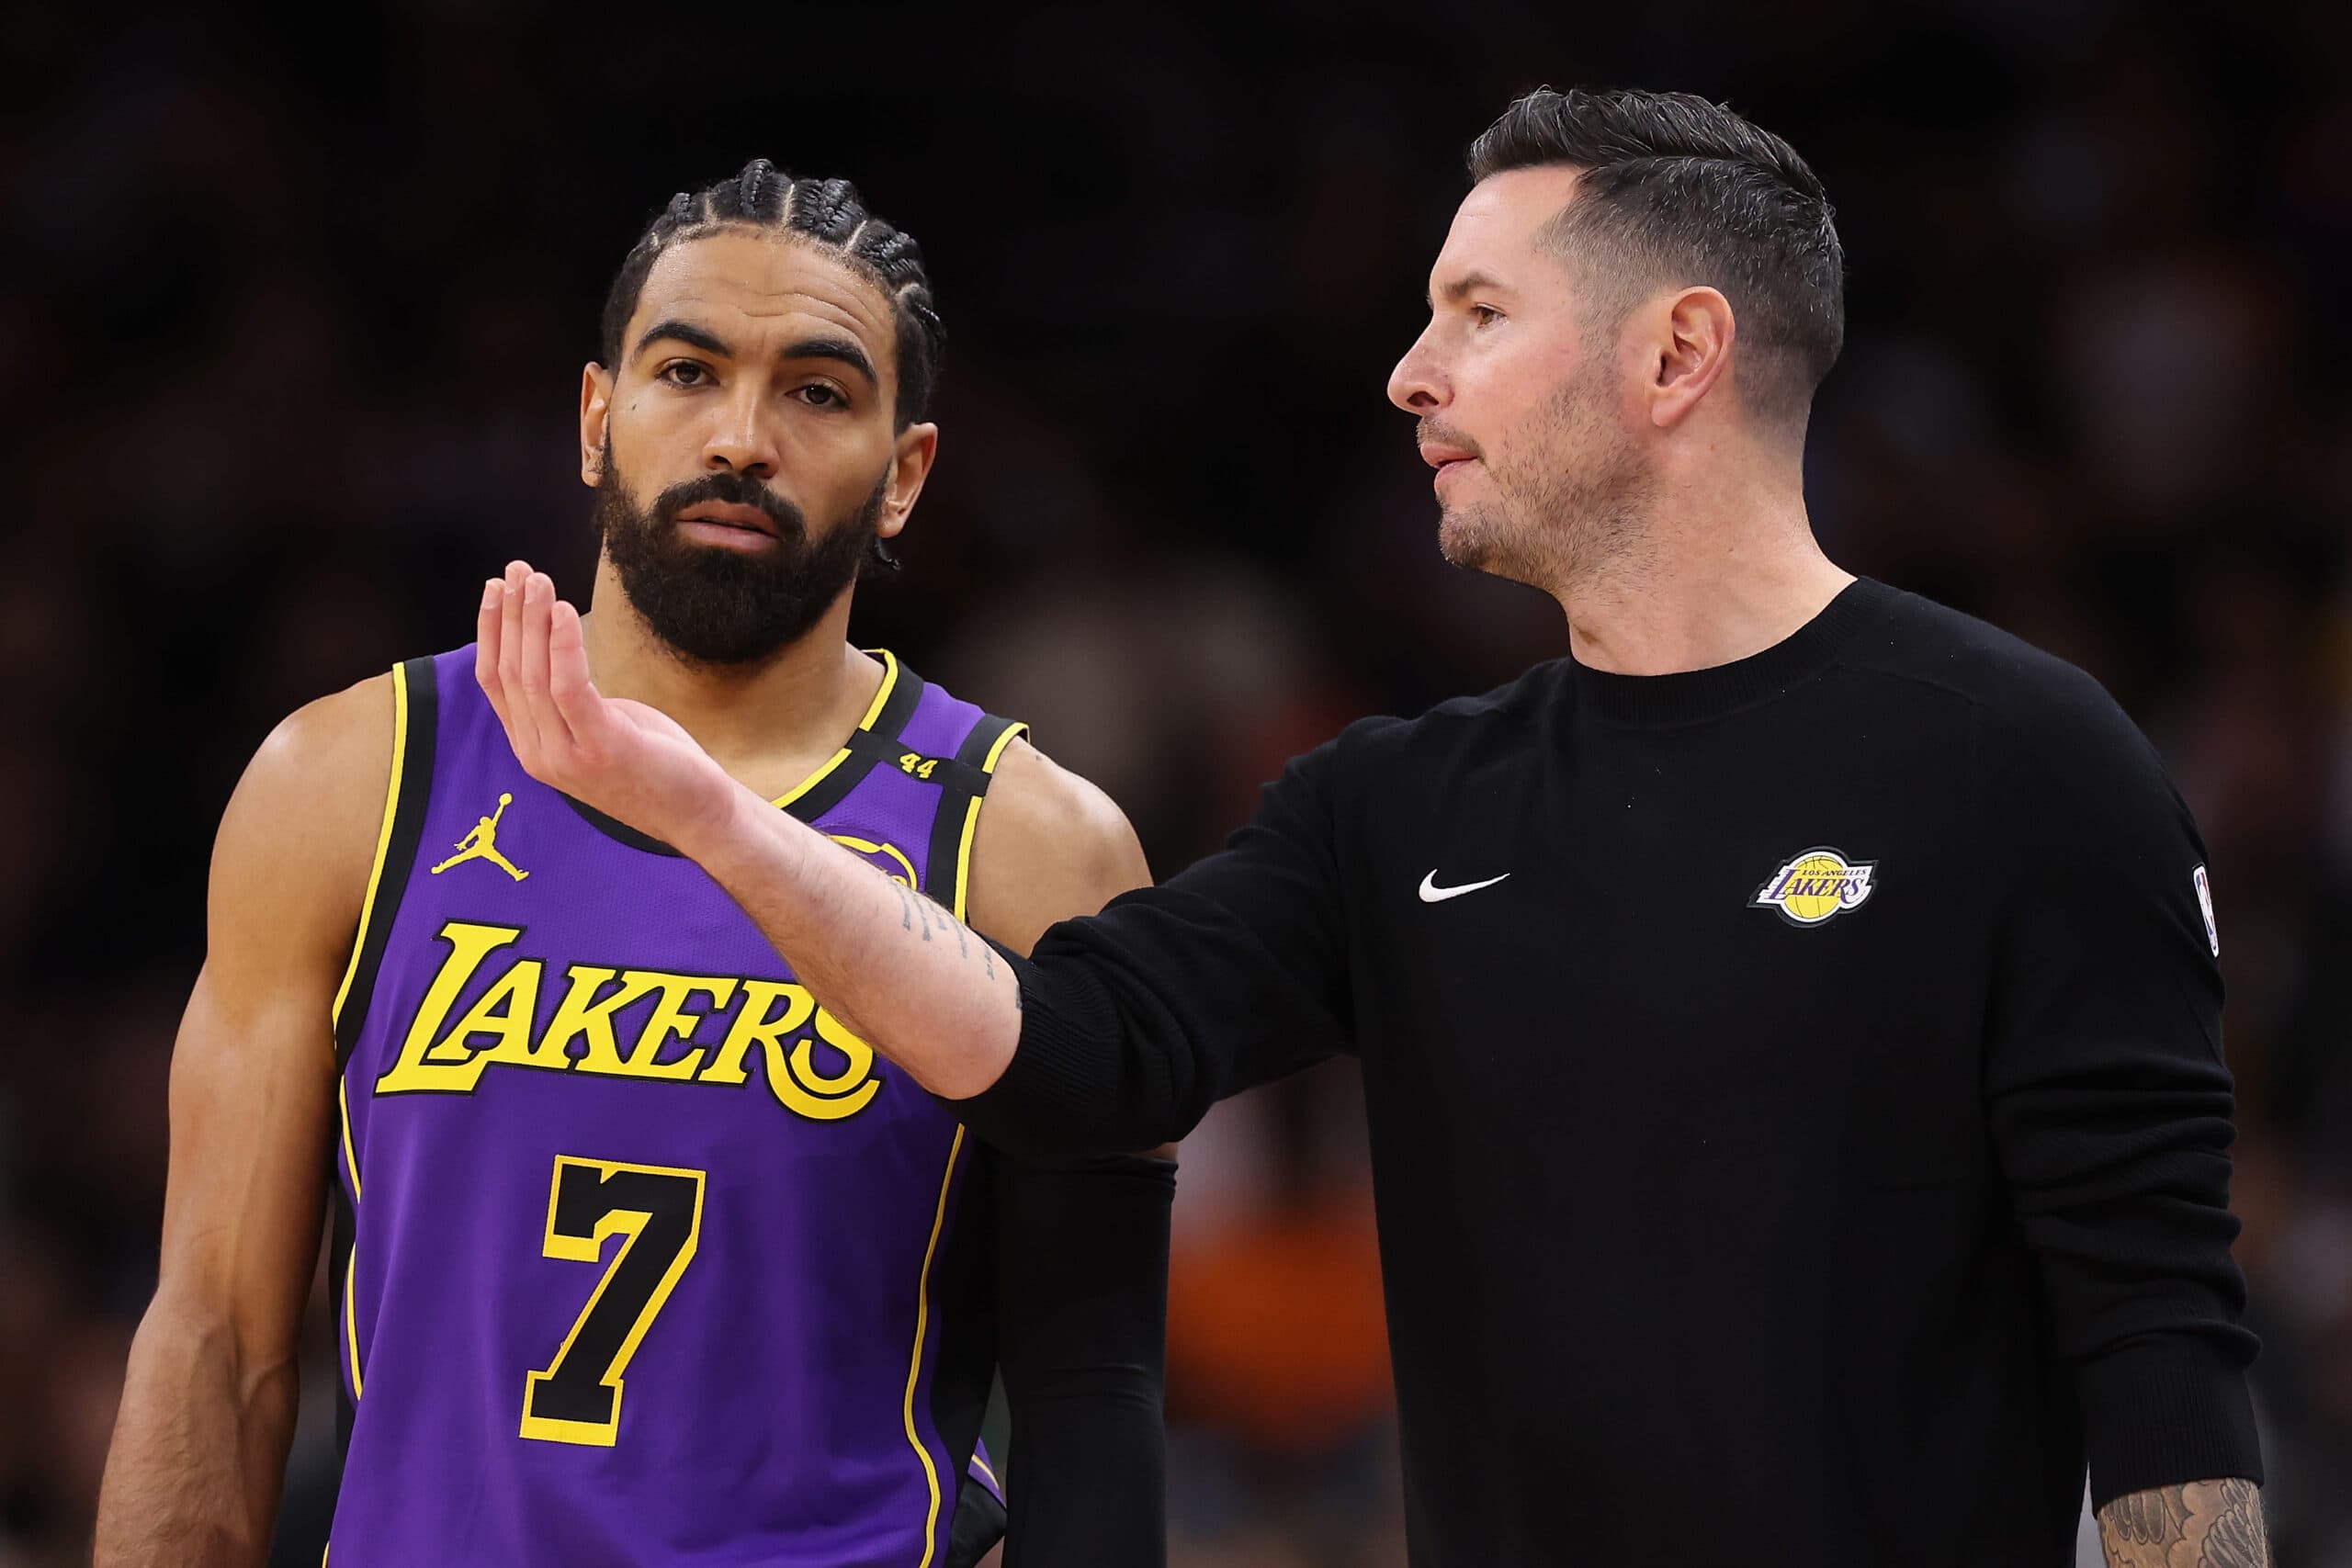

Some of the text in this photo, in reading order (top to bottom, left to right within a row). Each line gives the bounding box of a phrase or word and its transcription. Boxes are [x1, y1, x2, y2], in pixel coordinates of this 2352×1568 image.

[899, 751, 938, 779] 44
[1763, 869, 1865, 904] LAKERS
[373, 919, 883, 1122] LAKERS
[519, 1155, 707, 1447] 7
